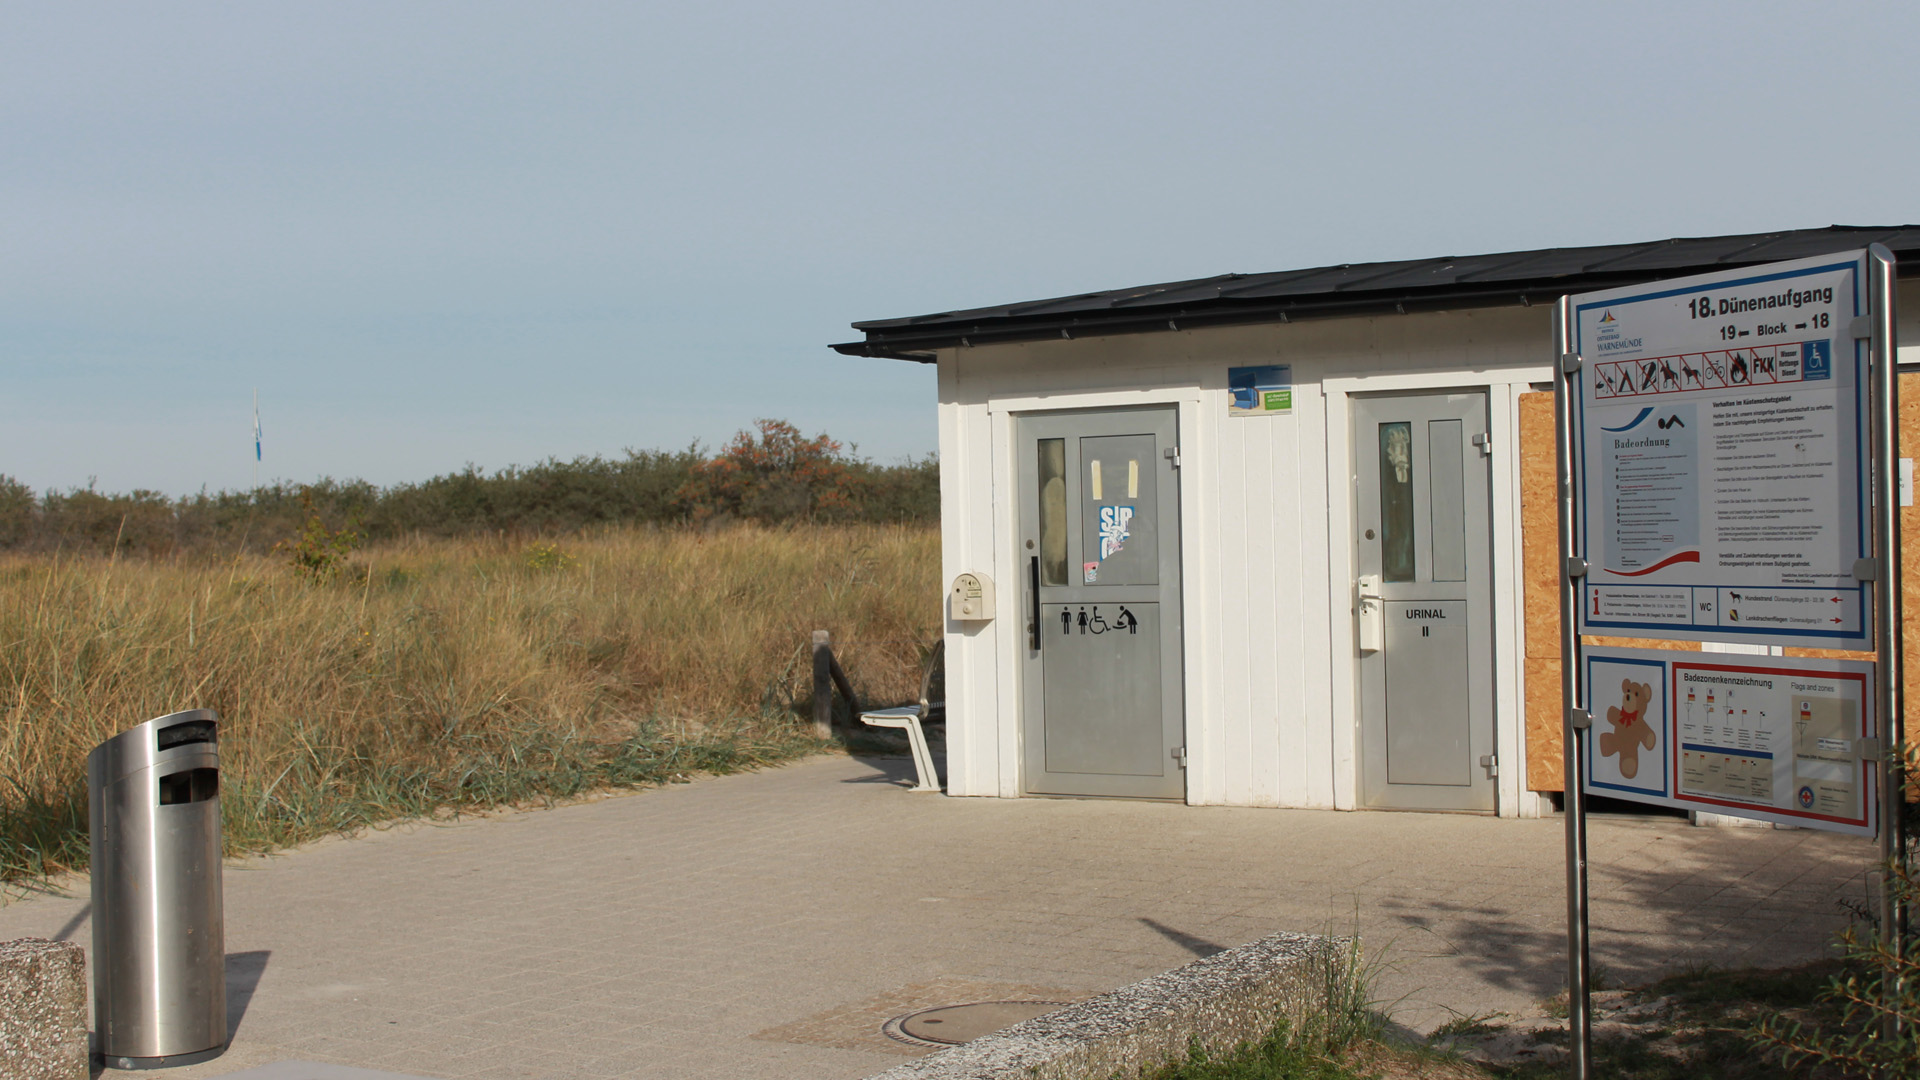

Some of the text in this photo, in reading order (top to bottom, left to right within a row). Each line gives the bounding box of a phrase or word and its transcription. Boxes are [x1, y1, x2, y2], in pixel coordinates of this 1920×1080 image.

[1688, 287, 1833, 320] 18. Dünenaufgang
[1720, 313, 1830, 341] 19 Block 18
[1597, 338, 1643, 352] WARNEMÜNDE
[1753, 356, 1775, 374] FKK
[1614, 437, 1671, 449] Badeordnung
[1405, 609, 1446, 619] URINAL
[1699, 602, 1712, 612] WC
[1683, 672, 1773, 690] Badezonenkennzeichnung
[1790, 682, 1835, 693] Flags and zones
